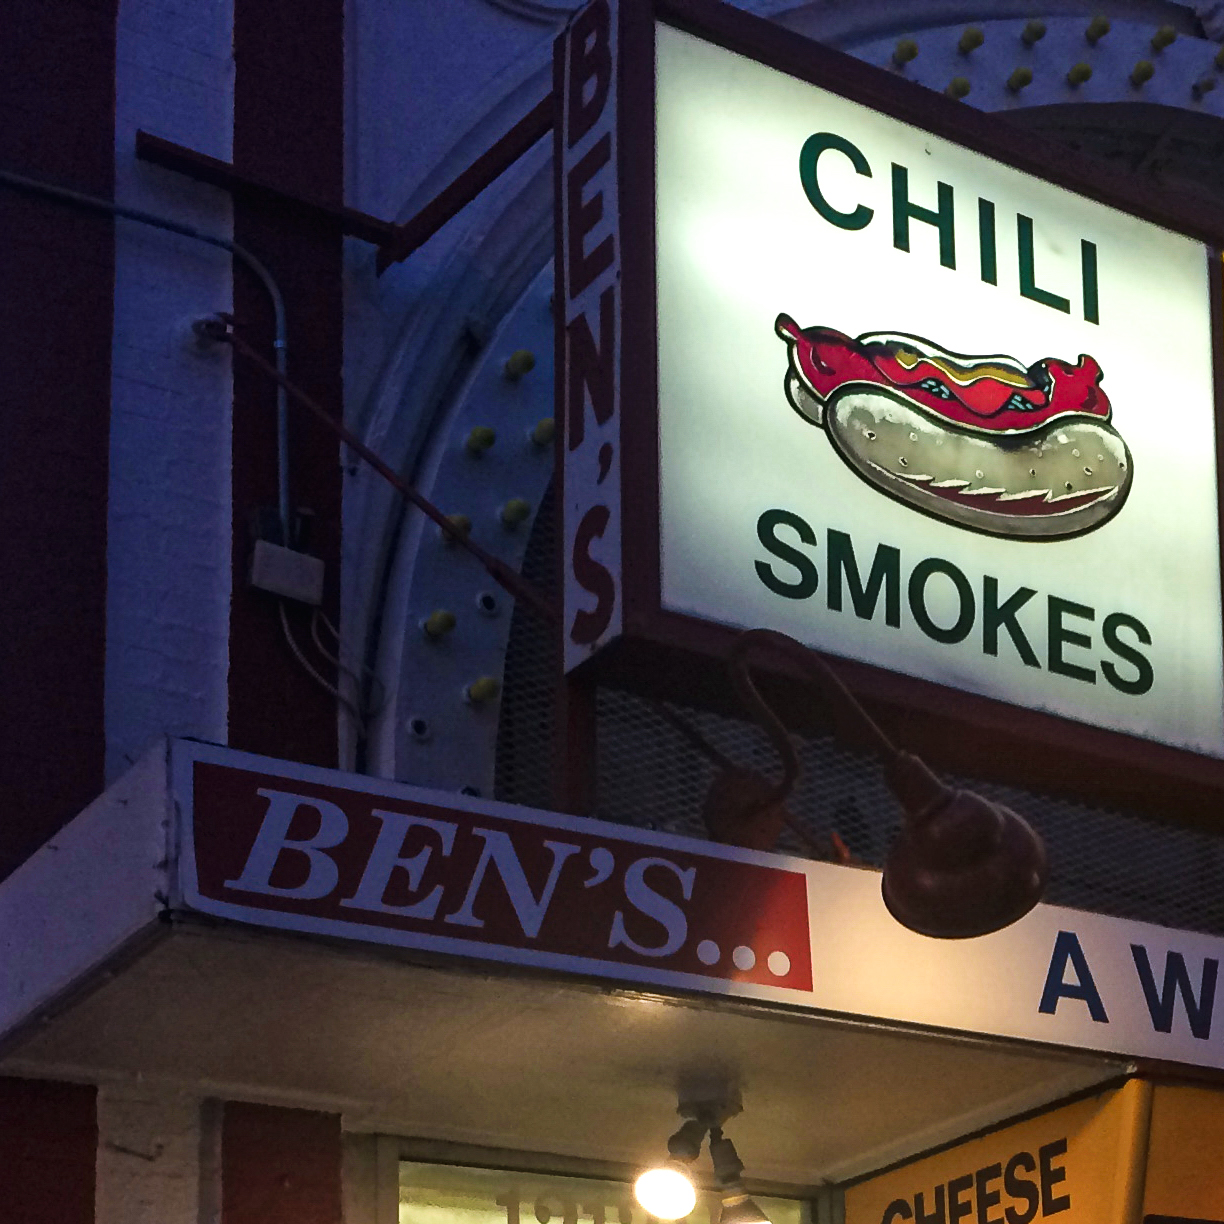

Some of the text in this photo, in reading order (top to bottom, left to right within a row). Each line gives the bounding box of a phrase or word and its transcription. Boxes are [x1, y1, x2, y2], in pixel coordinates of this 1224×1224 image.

[566, 0, 616, 646] BEN'S
[798, 131, 1100, 326] CHILI
[754, 508, 1155, 696] SMOKES
[1037, 929, 1108, 1025] A
